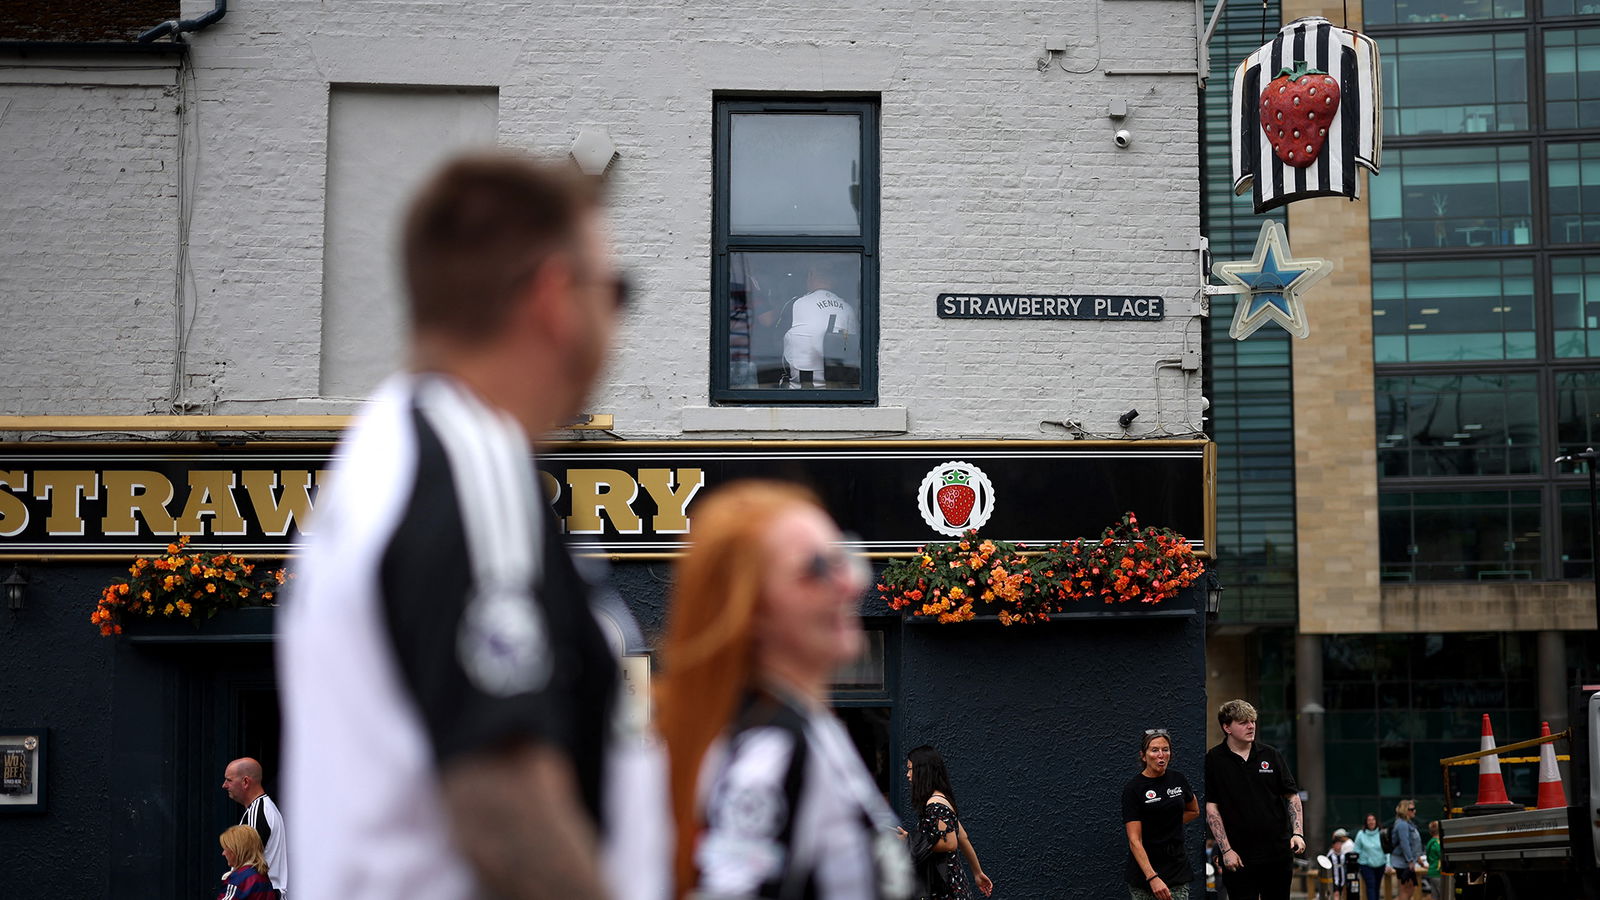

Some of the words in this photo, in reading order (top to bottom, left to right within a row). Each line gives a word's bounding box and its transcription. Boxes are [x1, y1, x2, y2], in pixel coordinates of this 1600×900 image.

[816, 299, 844, 311] HENDA
[943, 296, 1083, 316] STRAWBERRY
[1094, 298, 1161, 317] PLACE
[0, 468, 705, 536] STRAWRY
